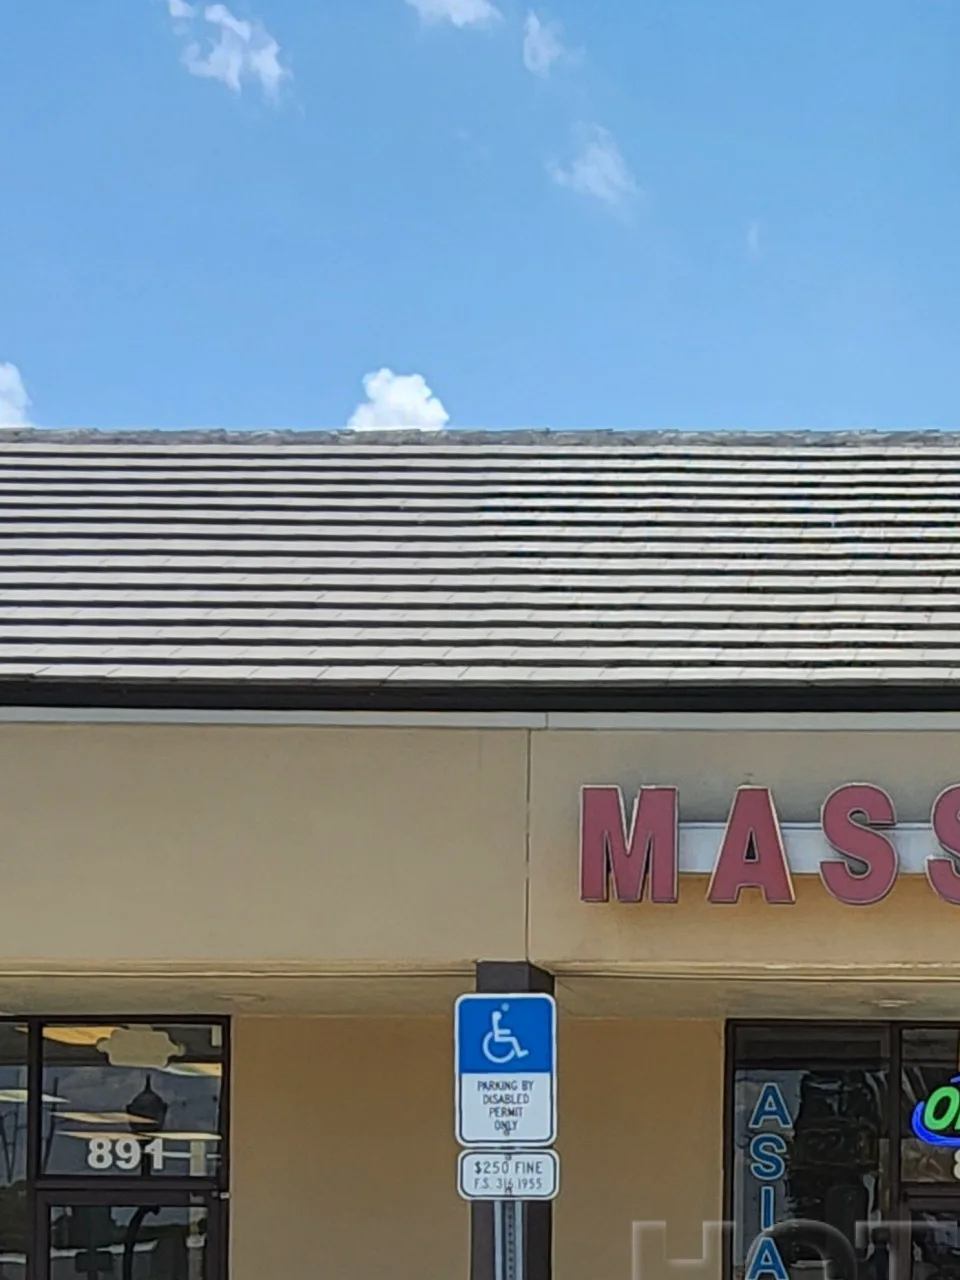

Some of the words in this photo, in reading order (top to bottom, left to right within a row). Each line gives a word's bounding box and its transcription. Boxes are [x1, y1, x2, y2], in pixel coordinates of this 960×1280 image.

[477, 1080, 517, 1091] PARKING
[521, 1080, 534, 1091] BY
[482, 1093, 530, 1105] DISABLED
[488, 1106, 523, 1118] PERMIT
[493, 1120, 518, 1131] ONLY
[87, 1137, 164, 1170] 891
[474, 1160, 510, 1175] $250
[514, 1160, 543, 1175] FINE
